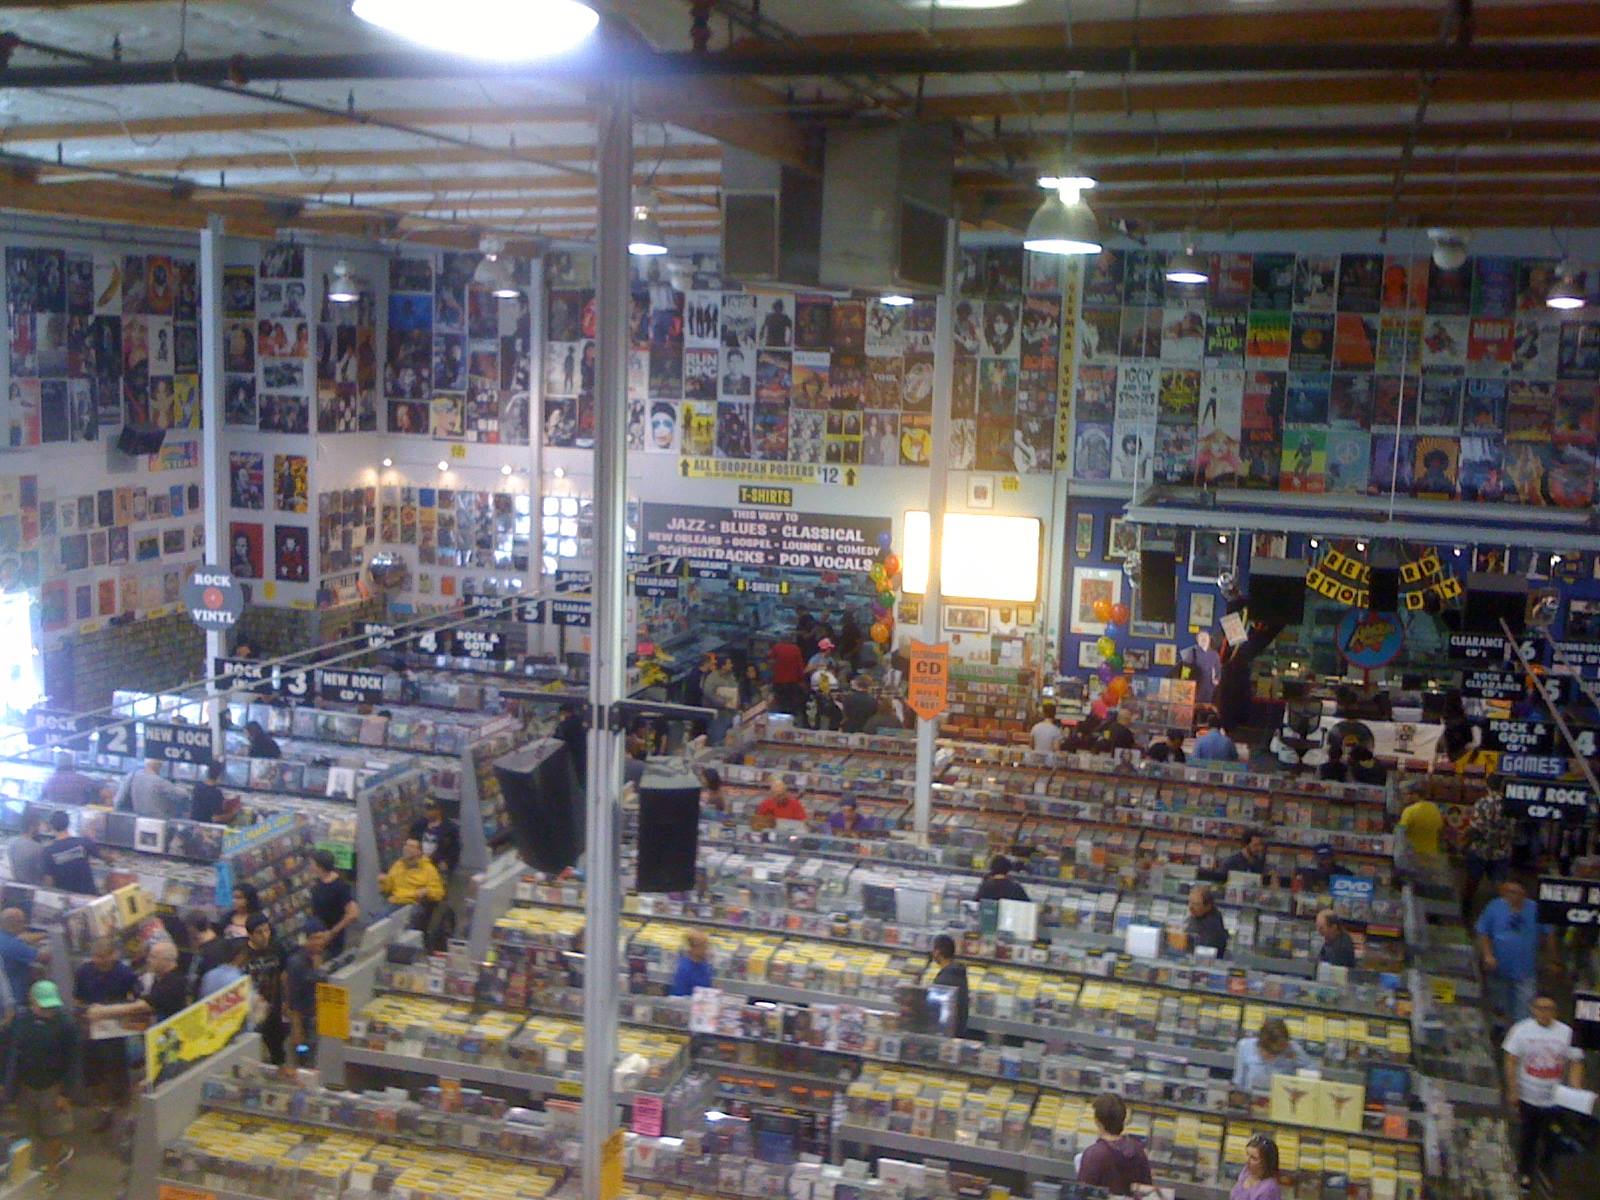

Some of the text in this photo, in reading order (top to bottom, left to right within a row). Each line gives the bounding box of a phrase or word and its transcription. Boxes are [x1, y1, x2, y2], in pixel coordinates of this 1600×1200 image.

[686, 352, 718, 367] RUN
[694, 459, 711, 472] ALL
[715, 460, 767, 474] EUROPEAN
[770, 463, 815, 477] POSTERS
[740, 487, 791, 505] T-SHIRTS
[732, 509, 800, 522] THIS WAY TO
[666, 518, 865, 543] JAZZ BLUES CLASSICAL
[647, 531, 881, 557] NEW ORLEANS GOSPEL LOUNGE COMEDY
[780, 552, 811, 567] POP
[813, 554, 874, 573] VOCALS
[193, 573, 232, 588] ROCK
[1408, 580, 1460, 608] DY
[191, 608, 236, 624] VINYL
[523, 600, 539, 620] 5
[419, 630, 438, 653] 4
[456, 629, 486, 641] ROCK
[463, 640, 494, 652] GOTH
[1450, 635, 1505, 649] CLEARANCE
[1519, 640, 1537, 660] 6
[915, 660, 942, 675] CD
[287, 668, 308, 695] 3
[323, 672, 349, 686] NEW
[351, 674, 382, 690] ROCK
[1544, 678, 1561, 702] 5
[1489, 720, 1527, 733] ROCK
[106, 725, 129, 753] 2
[145, 726, 173, 743] NEW
[177, 729, 211, 747] ROCK
[1498, 731, 1597, 757] GOTH 4
[1502, 753, 1561, 775] GAMES
[1505, 783, 1588, 806] NEW ROCK
[1540, 882, 1583, 904] NEW
